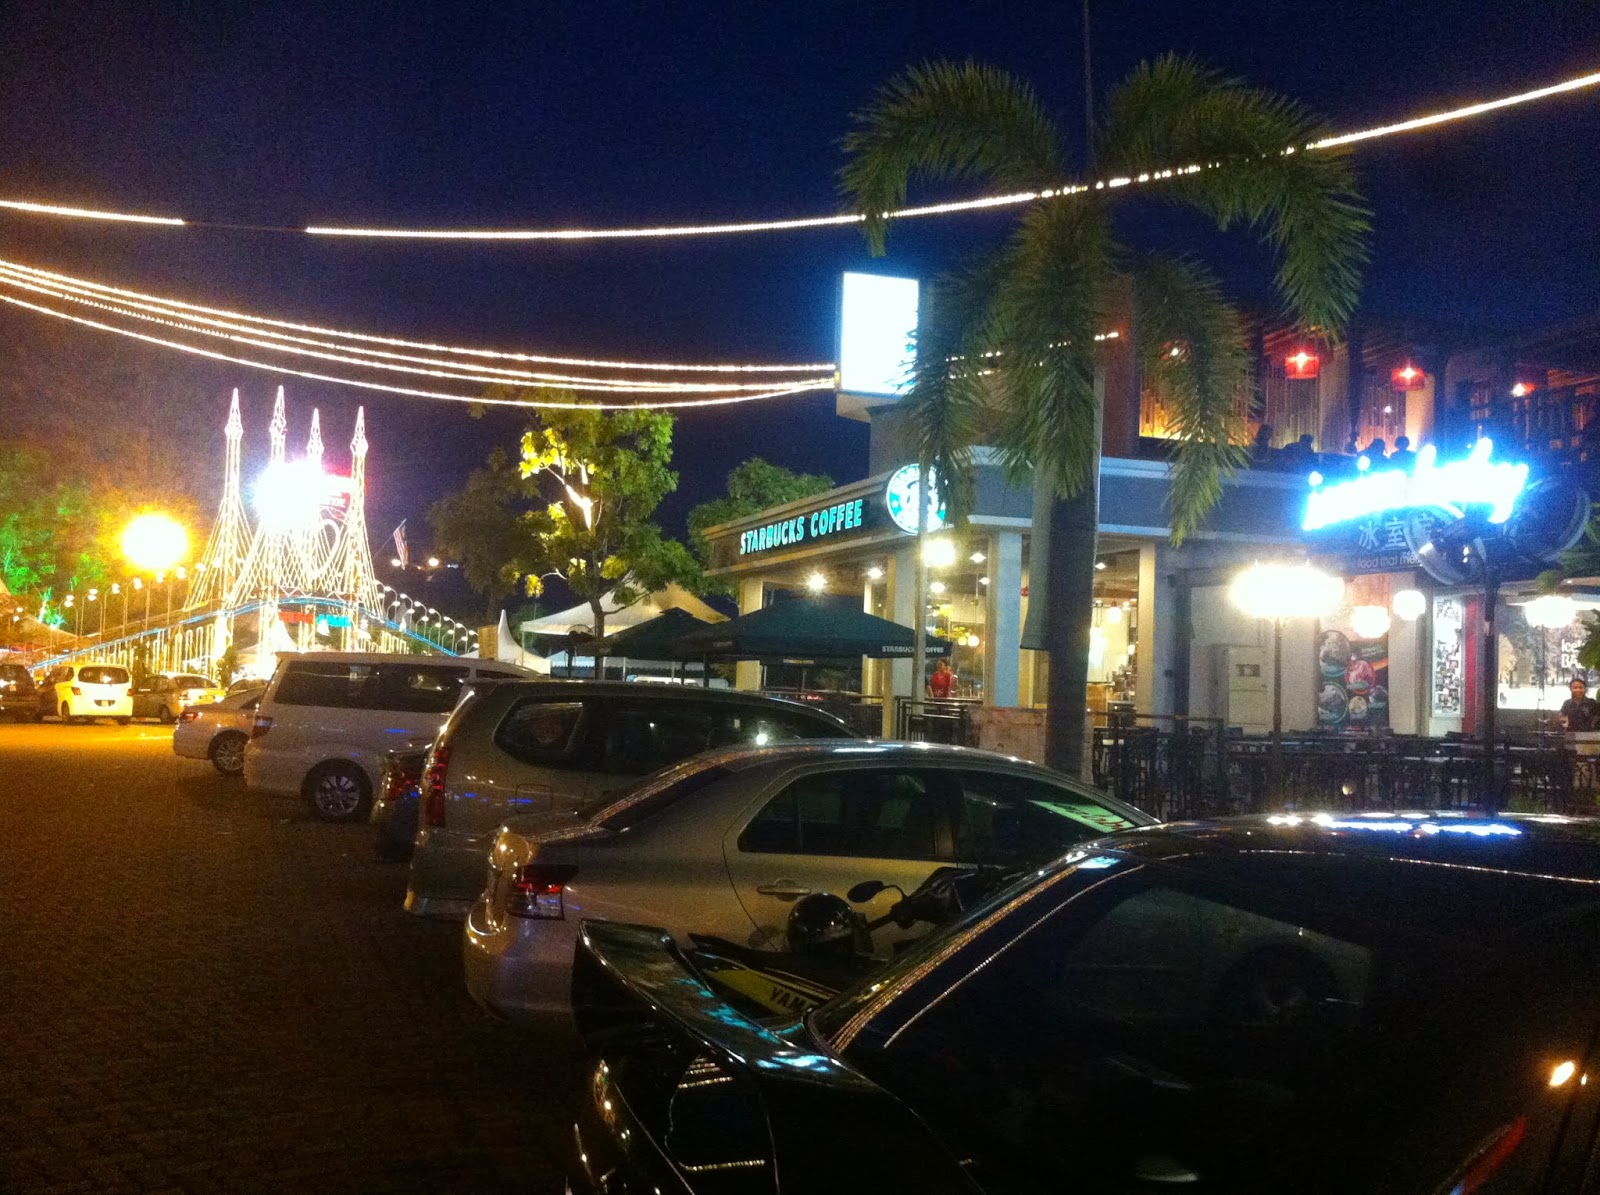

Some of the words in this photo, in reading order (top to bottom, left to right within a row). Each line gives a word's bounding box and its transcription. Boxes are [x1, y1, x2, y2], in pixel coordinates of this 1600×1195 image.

[740, 516, 804, 554] STARBUCKS
[810, 499, 863, 538] COFFEE
[881, 645, 915, 654] STARBUC
[924, 646, 945, 654] OFFEE
